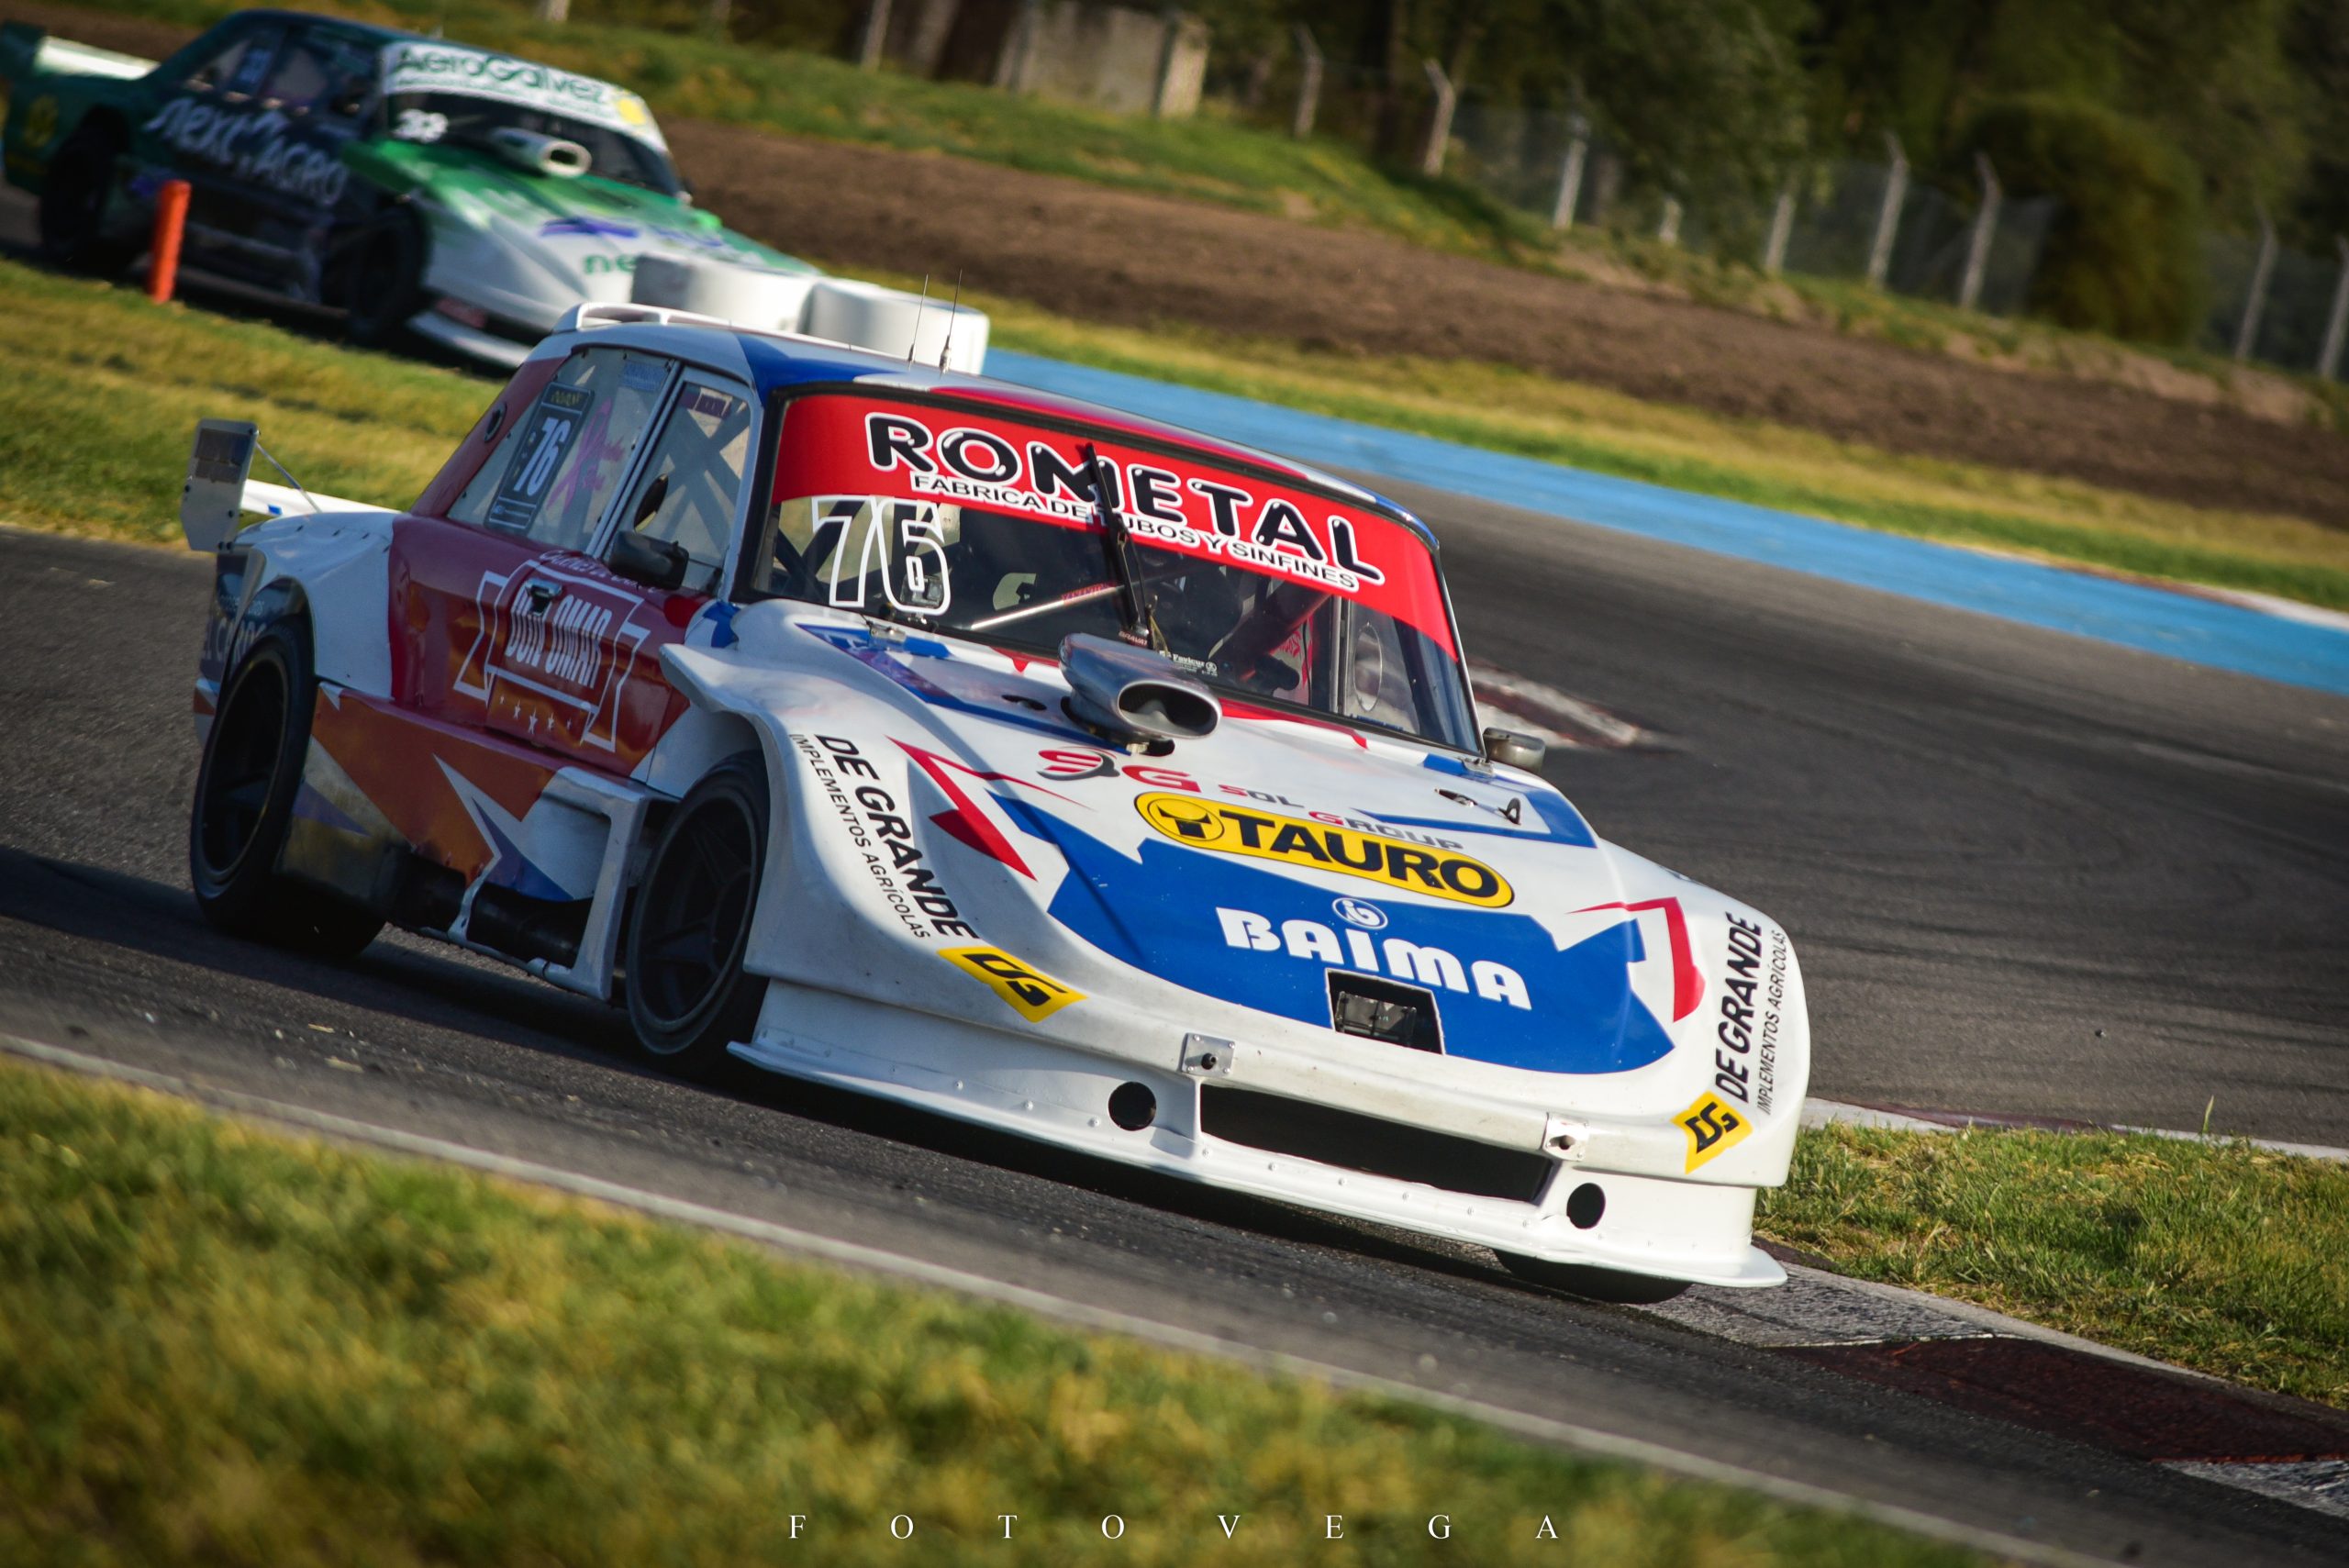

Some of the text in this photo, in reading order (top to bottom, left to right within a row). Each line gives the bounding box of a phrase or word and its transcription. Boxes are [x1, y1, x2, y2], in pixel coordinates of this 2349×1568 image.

[513, 417, 572, 496] 76
[865, 412, 1385, 585] ROMETAL
[811, 495, 952, 616] 76
[911, 472, 1044, 515] FABRICA
[1049, 498, 1093, 522] DE
[1204, 532, 1223, 551] Y
[1230, 542, 1356, 590] SINFINES
[545, 594, 613, 690] OMAR
[789, 733, 931, 940] IMPLEMENTOS AGRÍCOLAS
[813, 734, 981, 940] DE GRANDE
[1218, 784, 1464, 851] SOL GROUP
[1219, 808, 1500, 898] TAURO
[1216, 906, 1532, 1010] BAIMA
[1714, 910, 1763, 1105] DE GRANDE
[1756, 929, 1788, 1117] IMPLEMENTOS AGRÍCOLAS
